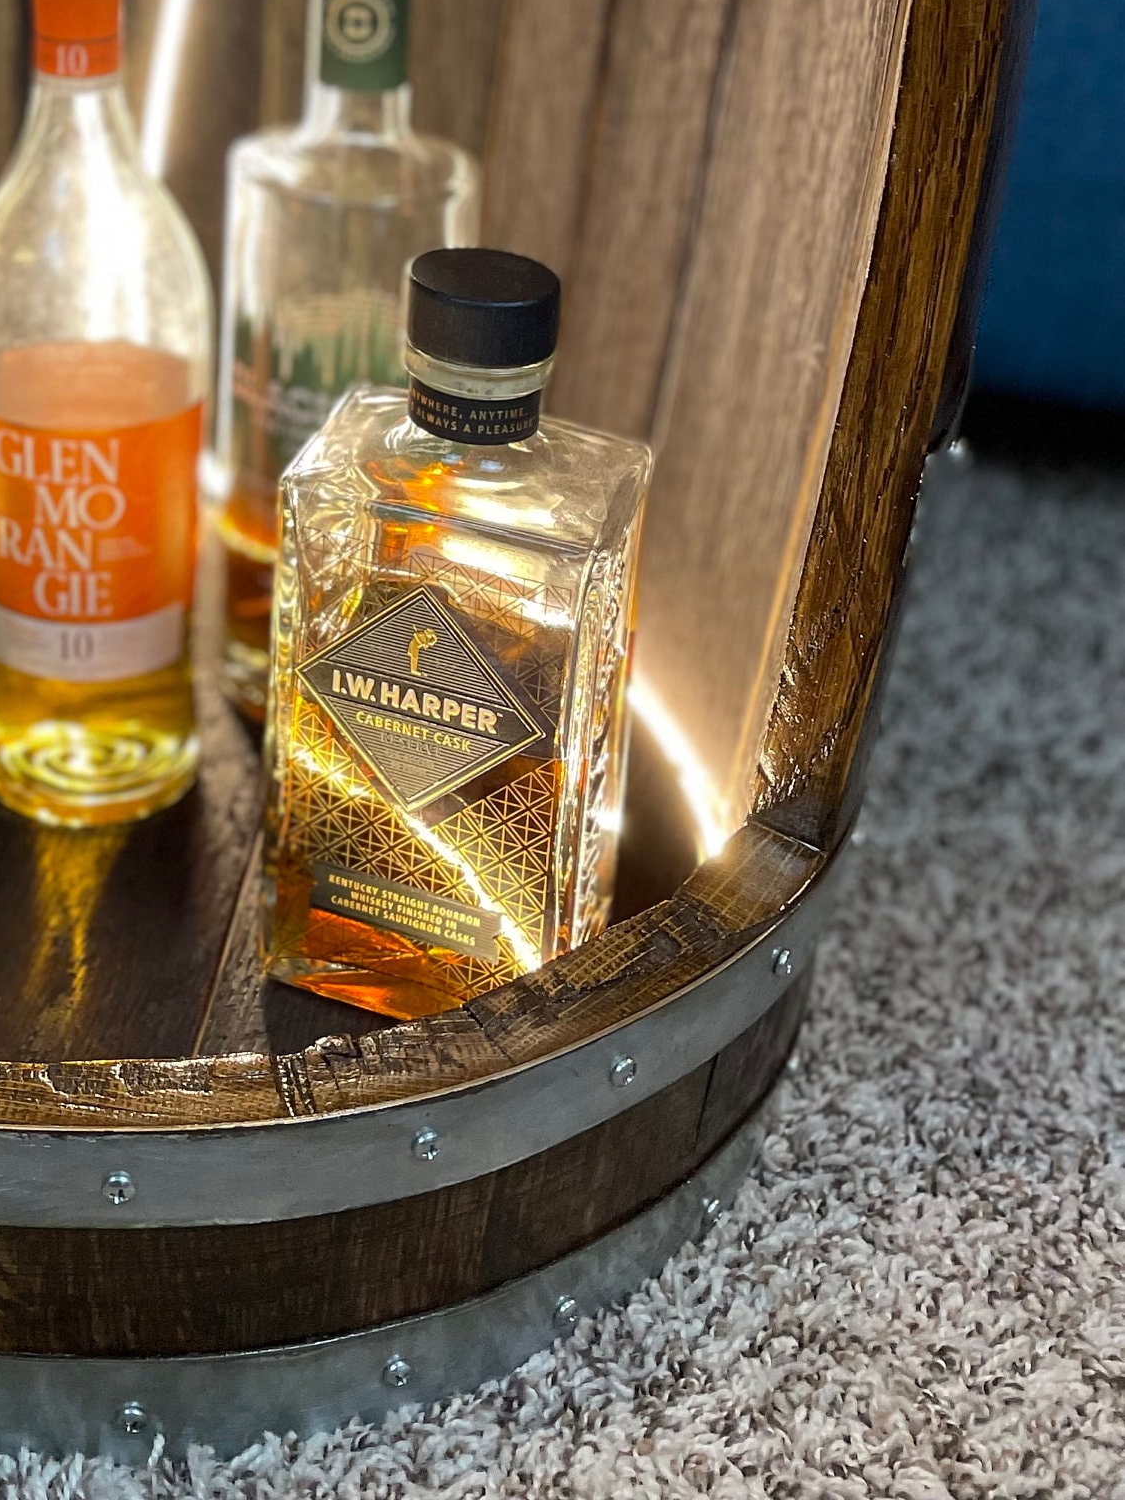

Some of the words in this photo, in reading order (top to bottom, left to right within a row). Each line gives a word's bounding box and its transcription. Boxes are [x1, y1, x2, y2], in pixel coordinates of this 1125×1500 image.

[54, 43, 90, 75] 10
[416, 408, 457, 431] ALWAYS
[463, 424, 471, 433] A
[34, 483, 126, 531] MO
[32, 570, 114, 617] GIE
[59, 631, 94, 661] 10
[332, 669, 376, 702] I.W.
[380, 682, 498, 735] HARPER
[355, 710, 429, 741] CABERNET
[433, 731, 472, 753] CASK
[328, 874, 378, 896] KENTUCKY
[382, 889, 430, 912] STRAIGHT
[432, 905, 481, 927] BOURBON
[331, 895, 380, 917] CABERNET
[382, 910, 441, 935] SAUVIGNON
[443, 929, 476, 947] CASKS
[350, 891, 394, 911] WHISKEY
[396, 904, 443, 925] FINISHED
[445, 919, 457, 930] IN
